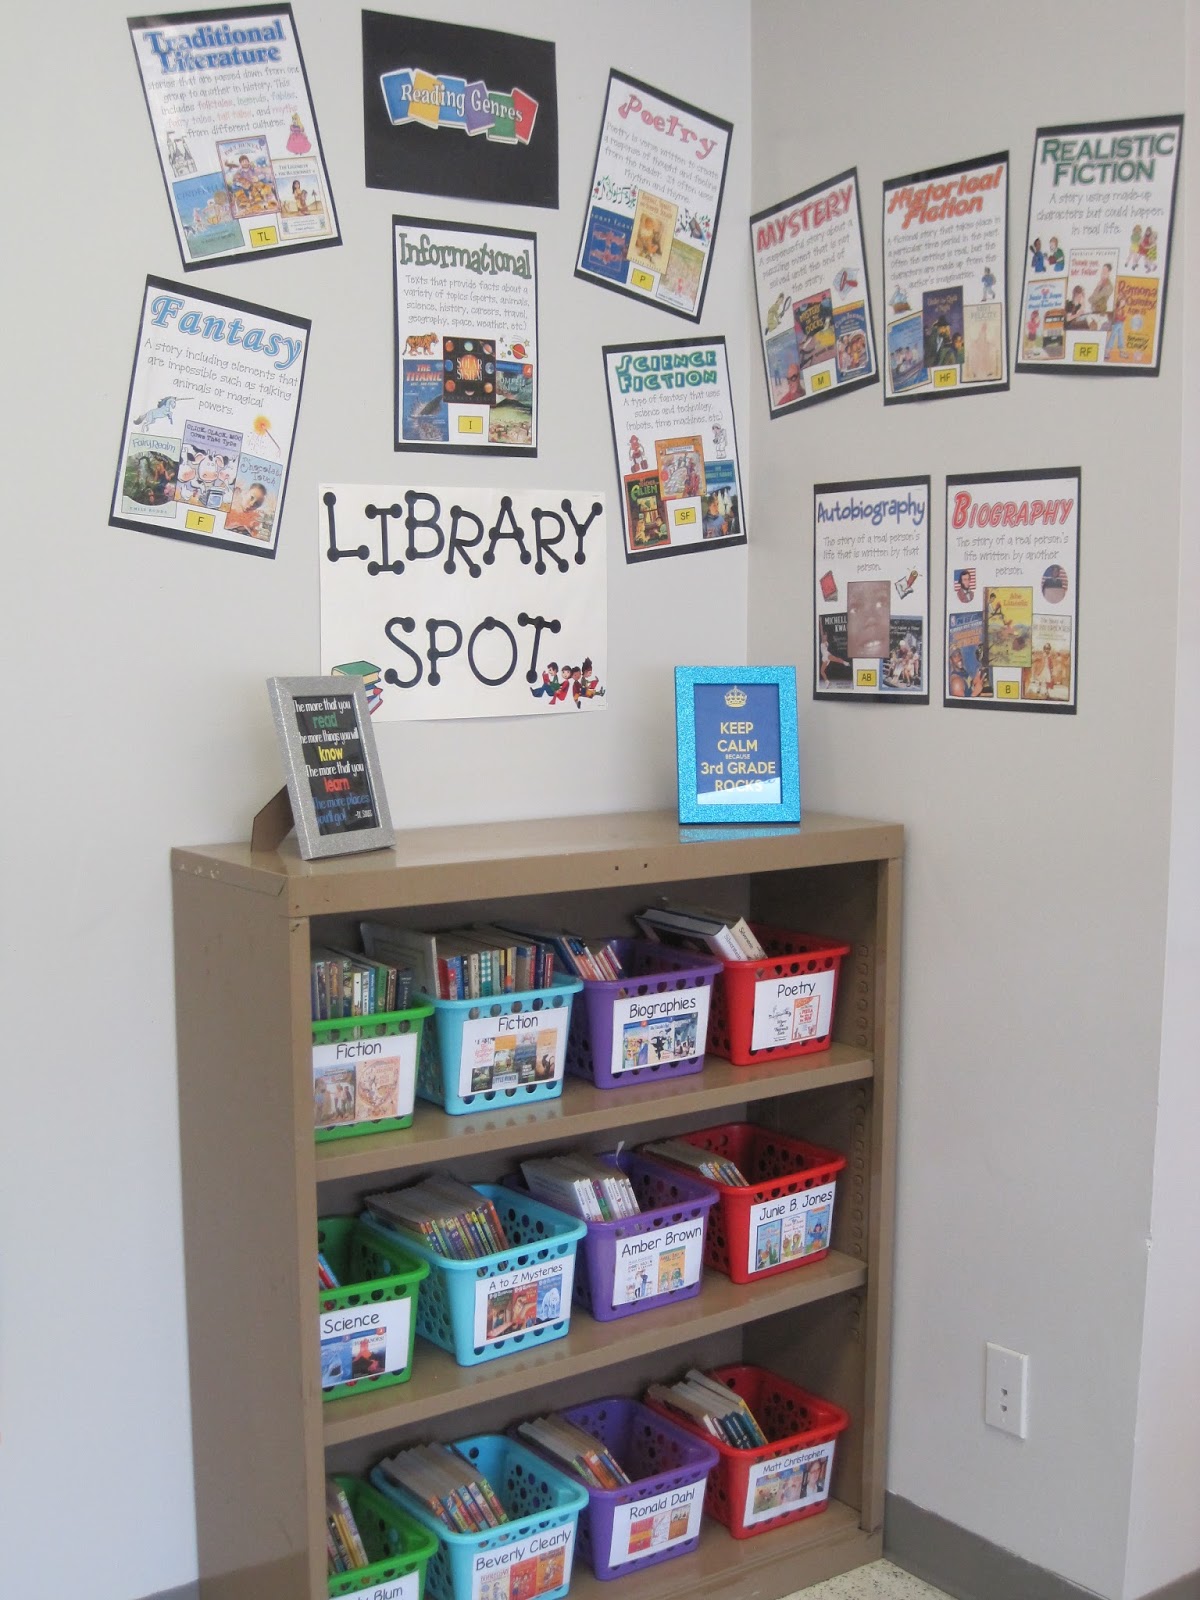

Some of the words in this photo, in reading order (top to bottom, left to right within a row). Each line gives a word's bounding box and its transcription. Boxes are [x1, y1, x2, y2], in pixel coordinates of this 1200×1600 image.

[143, 18, 286, 54] Traditional
[157, 46, 283, 75] Literature
[401, 83, 465, 117] Reading
[471, 89, 523, 122] Genres
[618, 94, 718, 160] Poetry
[1041, 133, 1176, 164] REALISTIC
[1053, 159, 1155, 187] FICTION
[757, 184, 853, 253] MYSTERY
[258, 232, 270, 242] TL
[399, 233, 532, 279] Informational
[151, 295, 302, 370] Fantasy
[144, 338, 152, 348] A
[155, 343, 183, 358] story
[186, 347, 228, 369] including
[231, 361, 276, 380] elements
[279, 374, 298, 387] that
[615, 350, 717, 373] SCIENCE
[1080, 348, 1091, 356] RF
[148, 357, 164, 366] are
[168, 359, 217, 380] impossible
[220, 375, 242, 387] such
[245, 381, 255, 390] as
[259, 383, 291, 401] talking
[618, 370, 717, 394] FICTION
[818, 376, 824, 384] M
[940, 373, 950, 382] HF
[172, 378, 212, 394] animals
[227, 390, 264, 407] magical
[681, 512, 690, 520] SF
[817, 492, 925, 526] Autobiography
[952, 491, 1074, 529] BIOGRAPHY
[197, 517, 204, 525] F
[323, 489, 603, 578] LIBRARY
[384, 612, 562, 689] SPOT
[1006, 685, 1011, 693] B
[306, 700, 323, 711] more
[324, 699, 338, 709] that
[338, 700, 351, 714] you
[313, 712, 338, 728] read
[720, 722, 753, 734] KEEP
[299, 733, 307, 743] he
[308, 732, 322, 742] more
[322, 730, 339, 746] things
[340, 731, 351, 745] you
[718, 739, 757, 752] CALM
[318, 746, 343, 762] know
[306, 765, 318, 777] The
[319, 764, 337, 775] more
[337, 762, 351, 773] that
[351, 762, 364, 776] you
[701, 762, 723, 774] 3rd
[727, 762, 775, 774] GRADE
[324, 778, 349, 792] learn
[715, 780, 763, 792] ROCKS
[778, 981, 816, 998] Poetry
[630, 998, 696, 1018] Biographies
[498, 1014, 539, 1031] Fiction
[336, 1040, 382, 1059] Fiction
[760, 1205, 785, 1220] Junie
[790, 1199, 799, 1212] B.
[802, 1191, 832, 1208] Jones
[622, 1238, 661, 1258] Amber
[665, 1227, 701, 1245] Brown
[489, 1281, 496, 1291] A
[500, 1279, 509, 1288] to
[512, 1275, 518, 1284] Z
[521, 1264, 562, 1282] Mysteries
[323, 1314, 379, 1334] Science
[763, 1463, 781, 1475] Matt
[784, 1449, 825, 1467] Christopher
[630, 1497, 667, 1519] Ronald
[671, 1488, 695, 1506] Dahl
[476, 1547, 525, 1571] Beverly
[529, 1530, 571, 1553] Clearly
[374, 1587, 403, 1600] Blum
